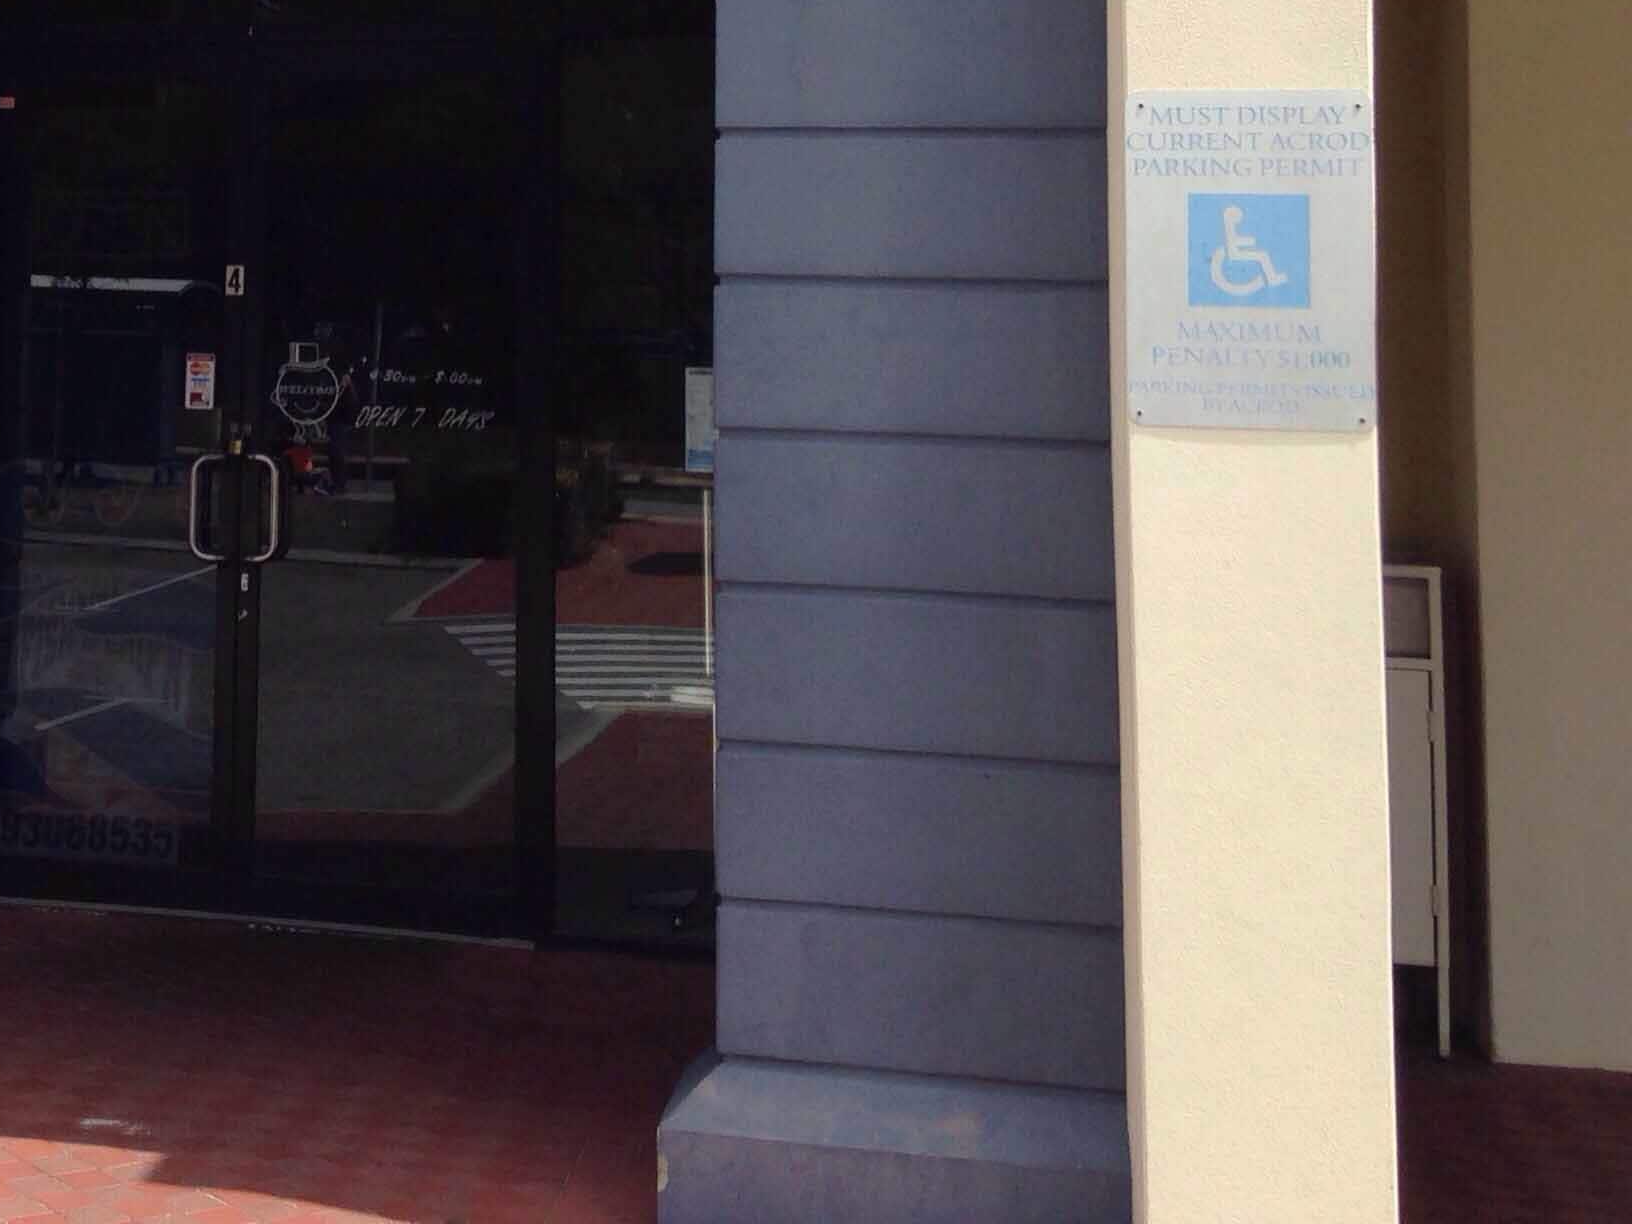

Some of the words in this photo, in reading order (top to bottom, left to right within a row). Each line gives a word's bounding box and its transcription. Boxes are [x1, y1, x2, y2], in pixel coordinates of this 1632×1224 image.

[1149, 105, 1229, 126] MUST
[1237, 105, 1346, 126] DISPLAY
[1127, 131, 1263, 153] CURRENT
[1270, 132, 1371, 153] ACROD
[1133, 157, 1253, 177] PARKING
[1259, 158, 1363, 178] PERMIT
[227, 268, 241, 293] 4
[1177, 321, 1322, 345] MAXIMUM
[1152, 346, 1272, 369] PENALTY
[355, 405, 406, 428] OPEN
[411, 406, 426, 428] 7
